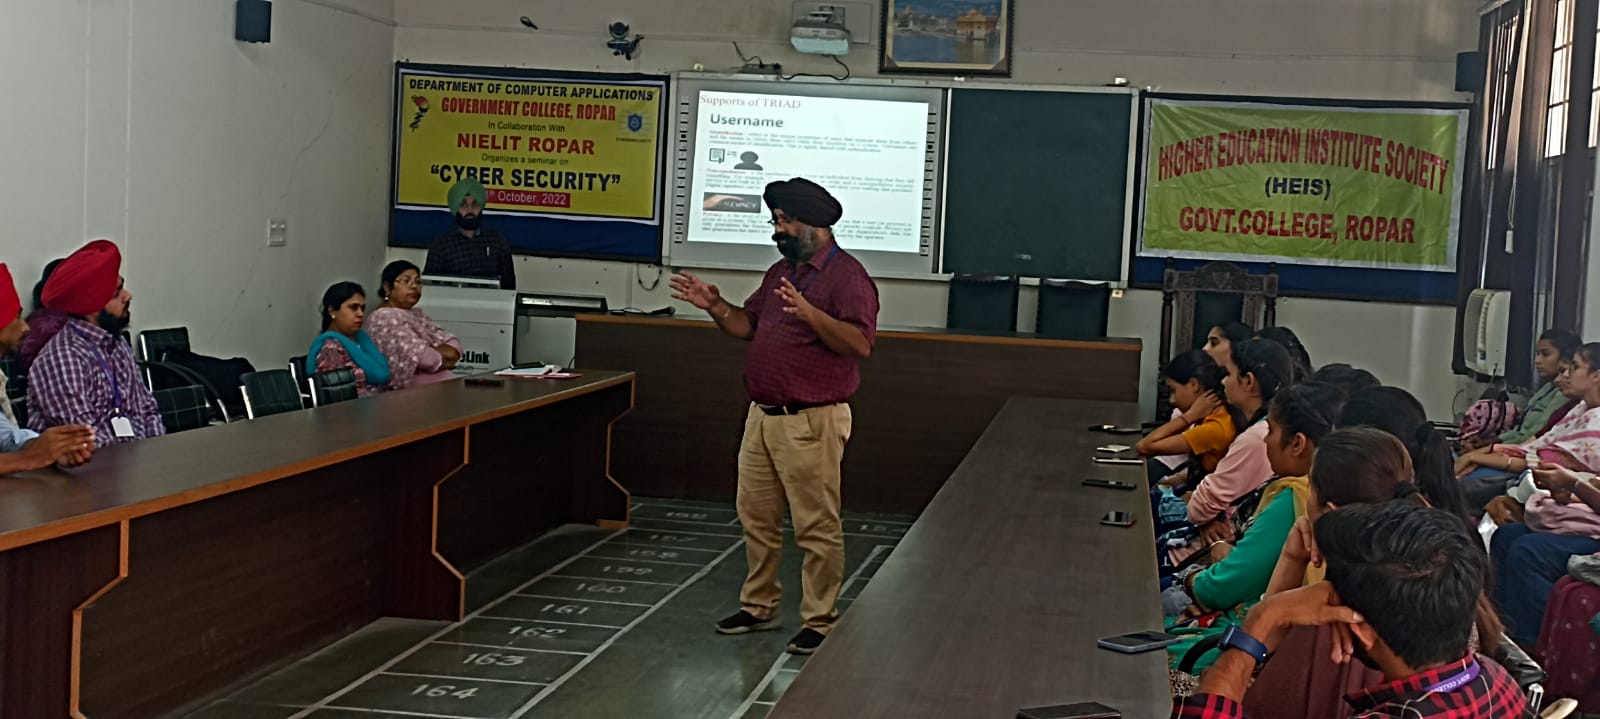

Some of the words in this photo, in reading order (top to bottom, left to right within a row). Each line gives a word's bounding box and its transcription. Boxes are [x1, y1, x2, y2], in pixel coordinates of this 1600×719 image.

[409, 79, 484, 93] DEPARTMENT
[487, 83, 502, 94] OF
[505, 84, 567, 97] COMPUTER
[571, 87, 654, 101] APPLICATIONS
[441, 97, 520, 116] GOVERNMENT
[522, 101, 574, 120] COLLEGE,
[576, 104, 616, 121] ROPAR
[700, 94, 745, 107] Supports
[748, 98, 759, 106] of
[763, 98, 801, 109] TRIAD
[488, 121, 495, 129] In
[497, 121, 546, 132] Collaboration
[549, 124, 565, 133] With
[710, 113, 784, 128] Username
[457, 133, 521, 151] NIELIT
[528, 136, 595, 155] ROPAR
[481, 153, 519, 164] Organizes
[528, 156, 558, 166] seminar
[1158, 135, 1214, 182] HIGHER
[1217, 127, 1301, 168] EDUCATION
[1304, 128, 1382, 174] INSTITUTE
[1385, 140, 1449, 195] SOCIETY
[1265, 176, 1331, 201] (HEIS)
[542, 192, 567, 205] 2022
[1345, 214, 1415, 244] ROPAR
[576, 583, 627, 593] 160
[541, 603, 591, 615] 161
[508, 626, 566, 638] 162
[463, 653, 527, 666] 163
[411, 683, 480, 700] 164
